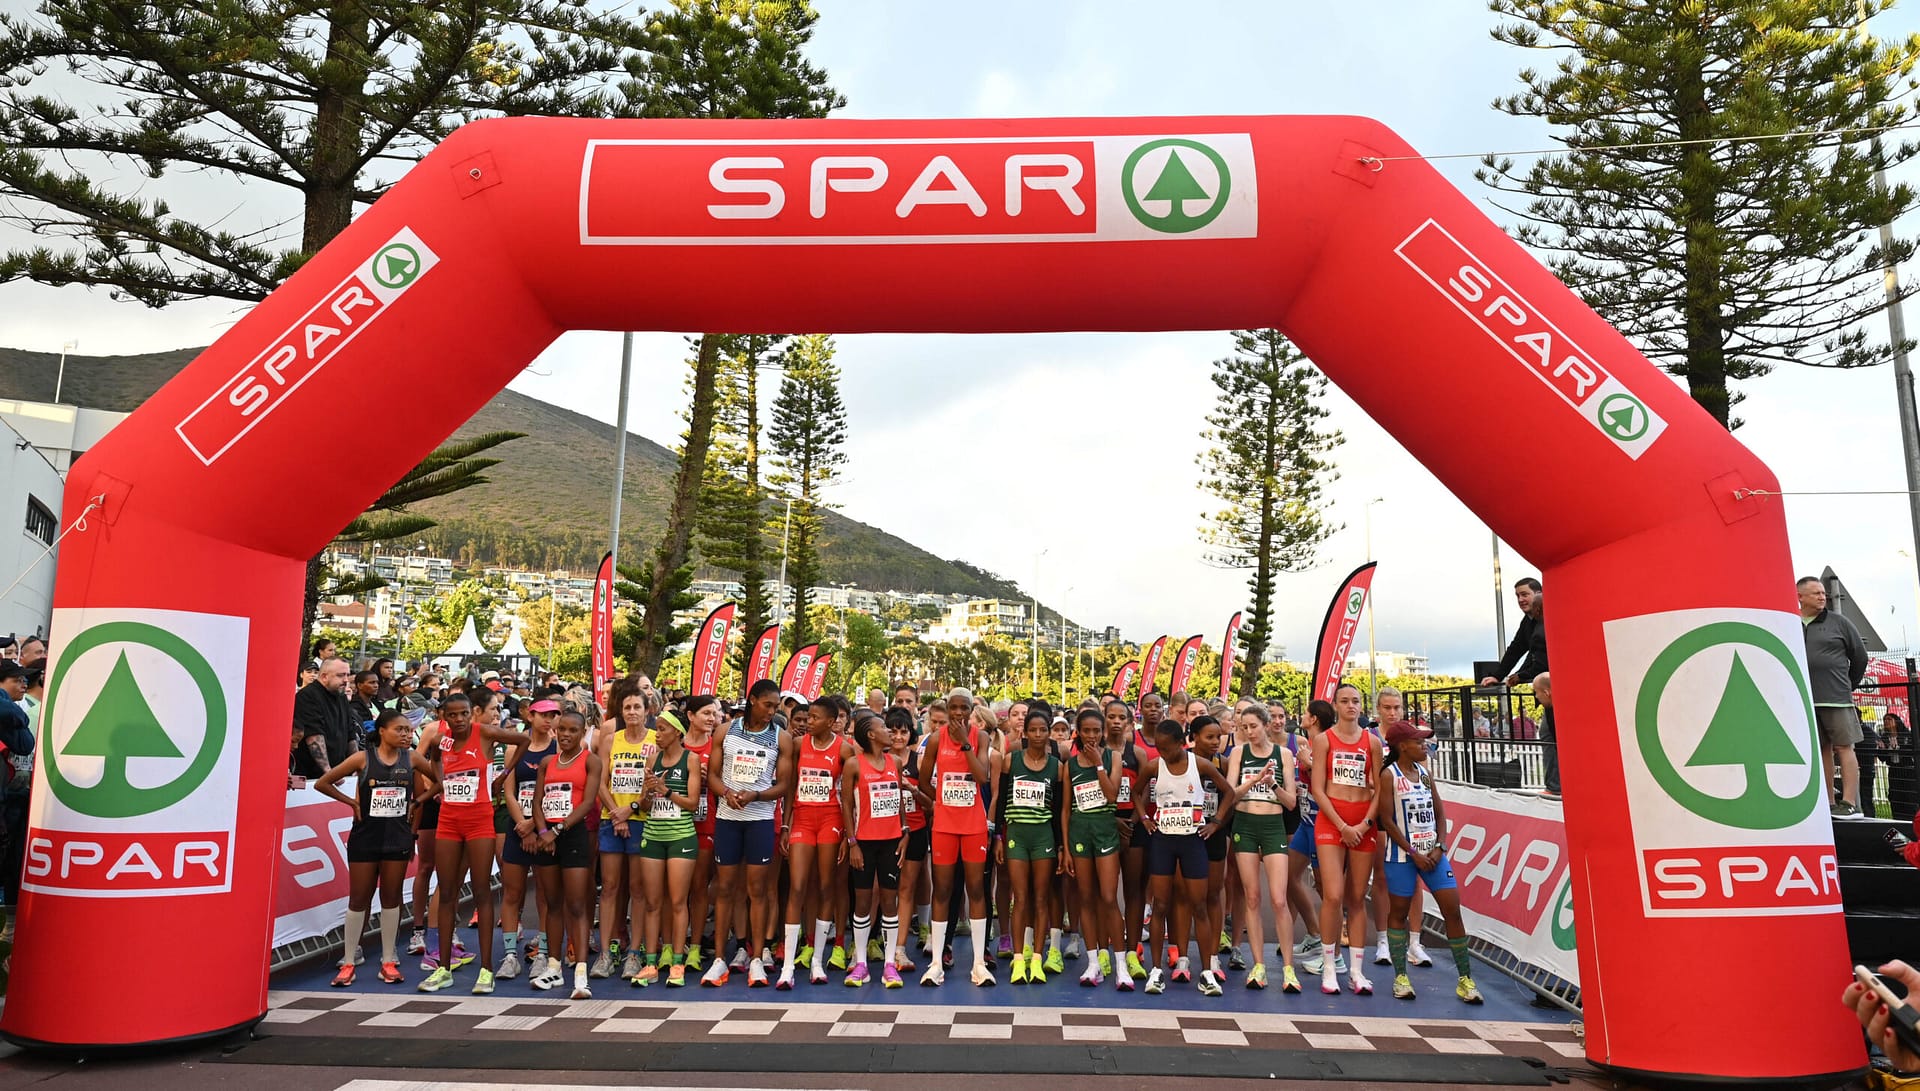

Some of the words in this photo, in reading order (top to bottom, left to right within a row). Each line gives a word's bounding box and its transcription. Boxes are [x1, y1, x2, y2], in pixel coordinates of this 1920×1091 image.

[707, 154, 1085, 220] SPAR
[1449, 266, 1597, 397] SPAR
[229, 286, 374, 416] SPAR
[1327, 621, 1354, 699] SPAR
[701, 643, 720, 696] SPAR
[440, 738, 454, 750] 40
[641, 744, 654, 756] 50
[1334, 767, 1364, 780] NICOLE
[613, 777, 643, 787] SUZANNE
[1397, 777, 1410, 792] 40
[448, 785, 471, 795] LEBO
[800, 785, 830, 796] KARABO
[944, 789, 974, 800] KARABO
[1015, 789, 1044, 801] SELAM
[372, 798, 405, 809] SHARLAN
[520, 799, 533, 809] TA
[653, 801, 675, 811] ANNA
[872, 798, 900, 811] GLENROSE
[1161, 816, 1192, 827] KARABO
[1407, 812, 1413, 824] P
[27, 837, 220, 881] SPAR
[1446, 819, 1560, 911] PAR
